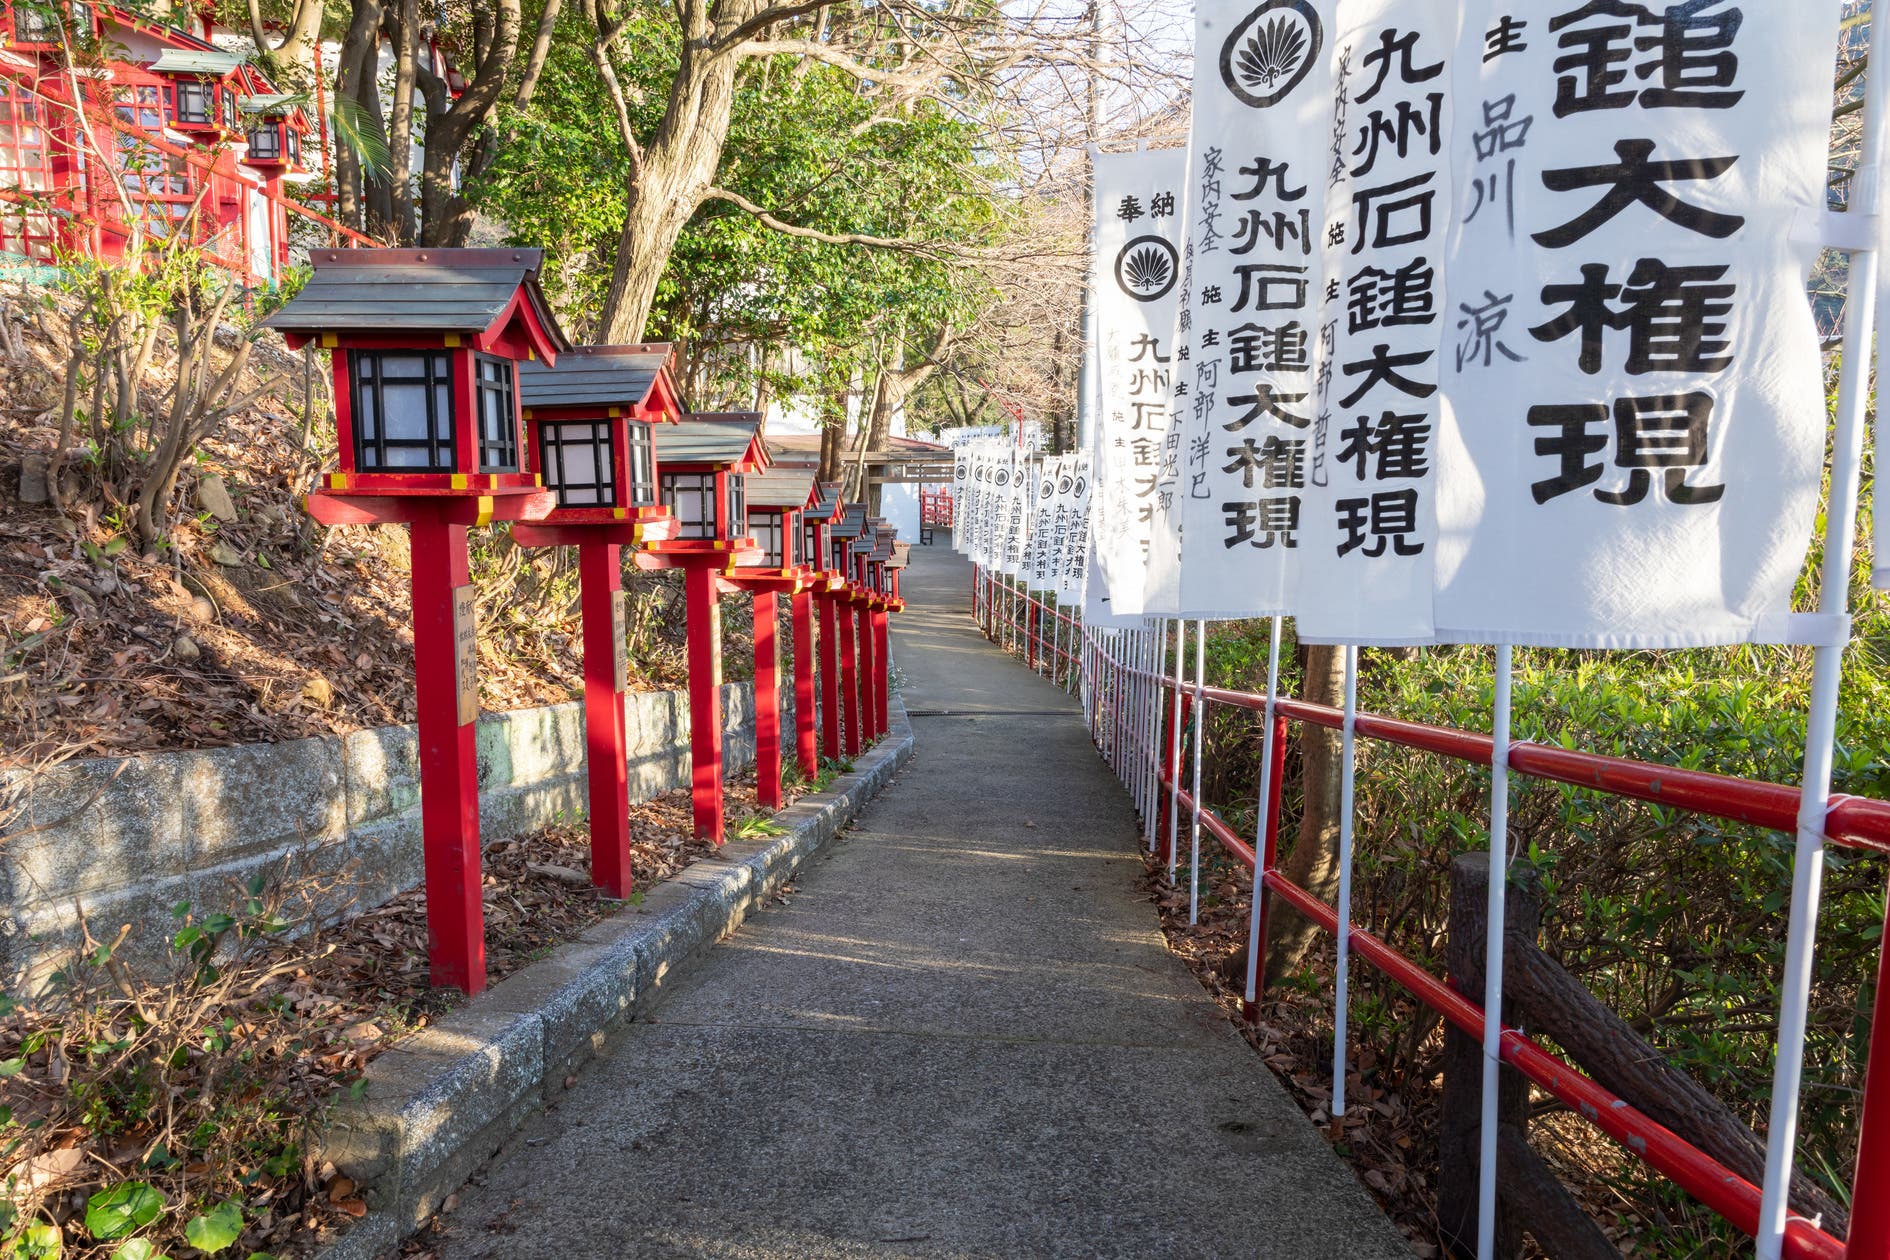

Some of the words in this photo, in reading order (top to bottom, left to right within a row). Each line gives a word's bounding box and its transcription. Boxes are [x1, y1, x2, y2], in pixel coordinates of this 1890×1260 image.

[1116, 191, 1175, 224] 奉納
[1198, 146, 1225, 255] 家内安全
[1200, 285, 1223, 349] 施主
[1222, 157, 1311, 549] 九州石鎚大権現
[1336, 28, 1445, 558] 九州石鎚大権現
[1128, 333, 1171, 566] 九州石鎚大
